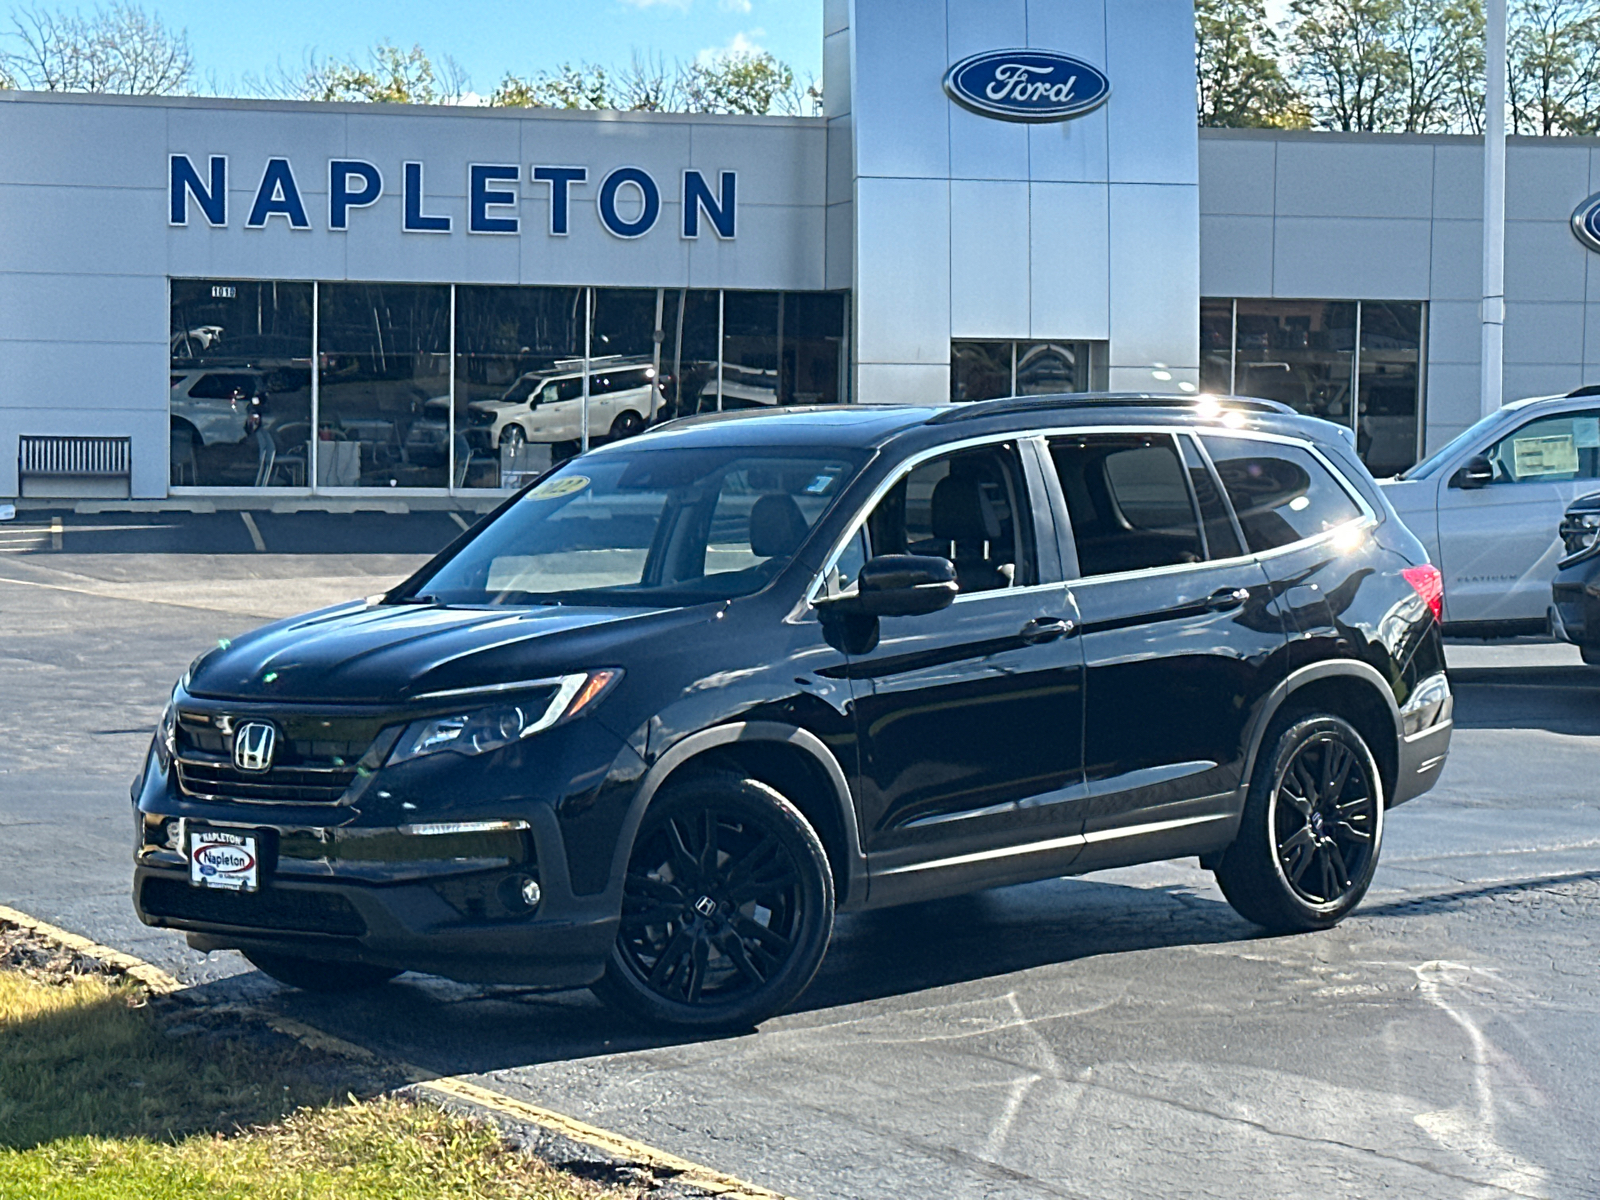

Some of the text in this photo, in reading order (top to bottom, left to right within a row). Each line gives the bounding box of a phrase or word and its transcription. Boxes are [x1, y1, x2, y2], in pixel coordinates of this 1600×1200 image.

[985, 63, 1077, 102] Ford
[169, 153, 736, 240] NAPLETON
[203, 832, 241, 844] NAPLETON
[204, 850, 245, 867] Napleton
